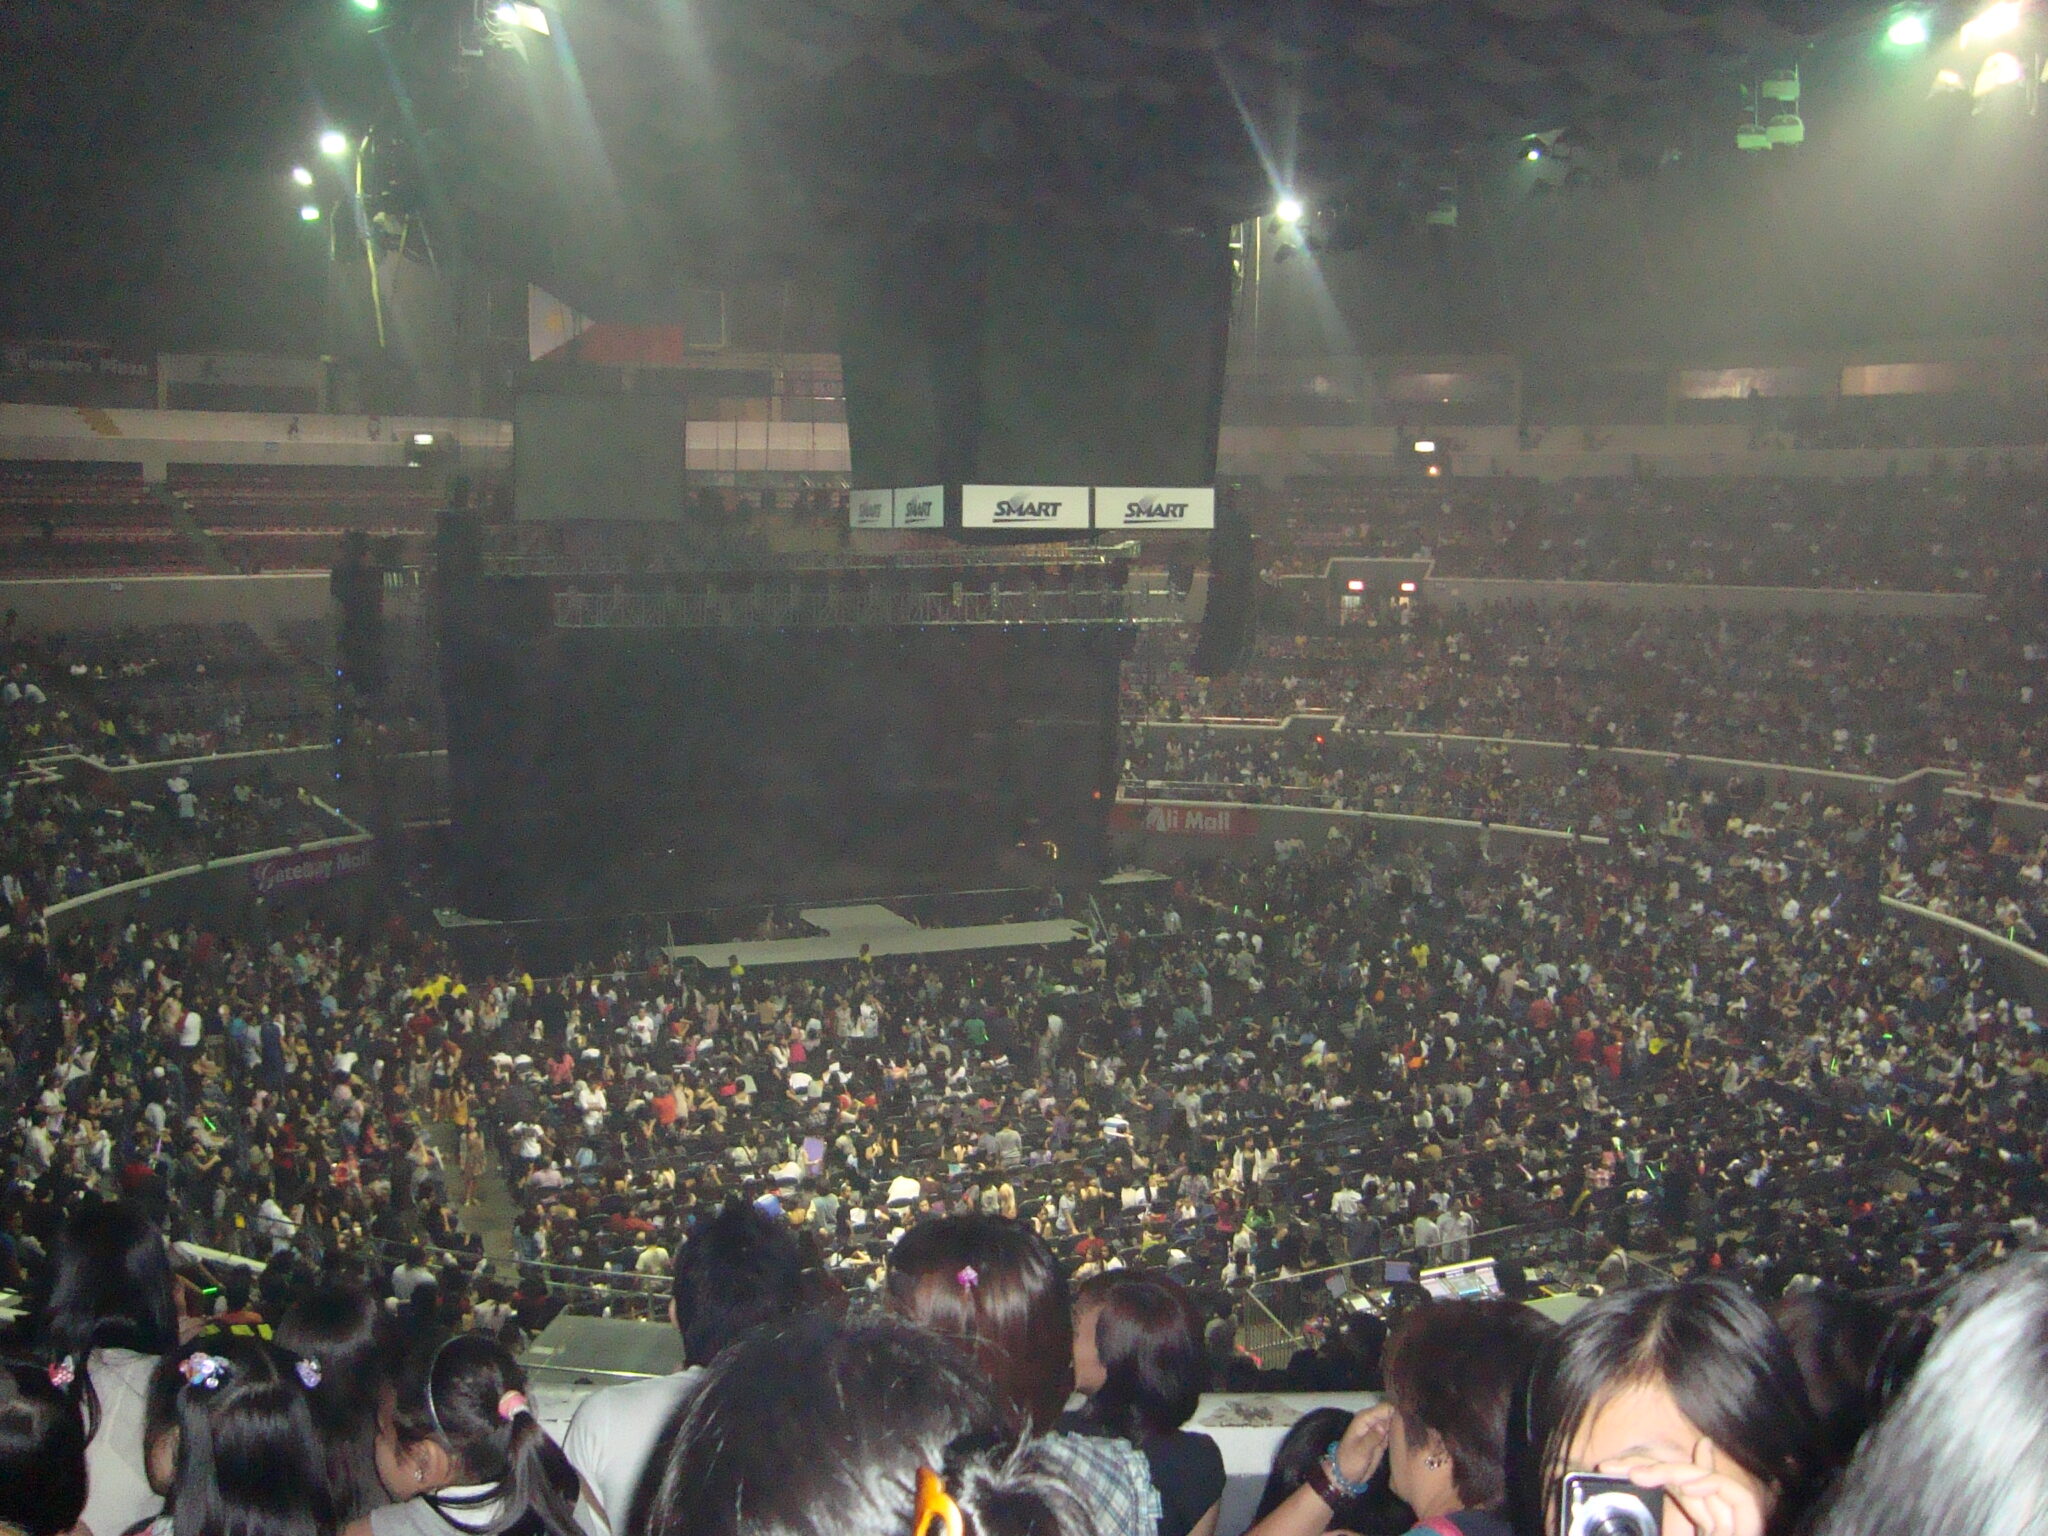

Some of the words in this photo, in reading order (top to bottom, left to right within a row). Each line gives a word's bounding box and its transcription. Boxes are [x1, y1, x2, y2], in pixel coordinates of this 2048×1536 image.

[905, 501, 932, 518] SMART
[994, 500, 1062, 518] SMART
[1125, 502, 1188, 519] SMART
[1184, 809, 1230, 832] Mall
